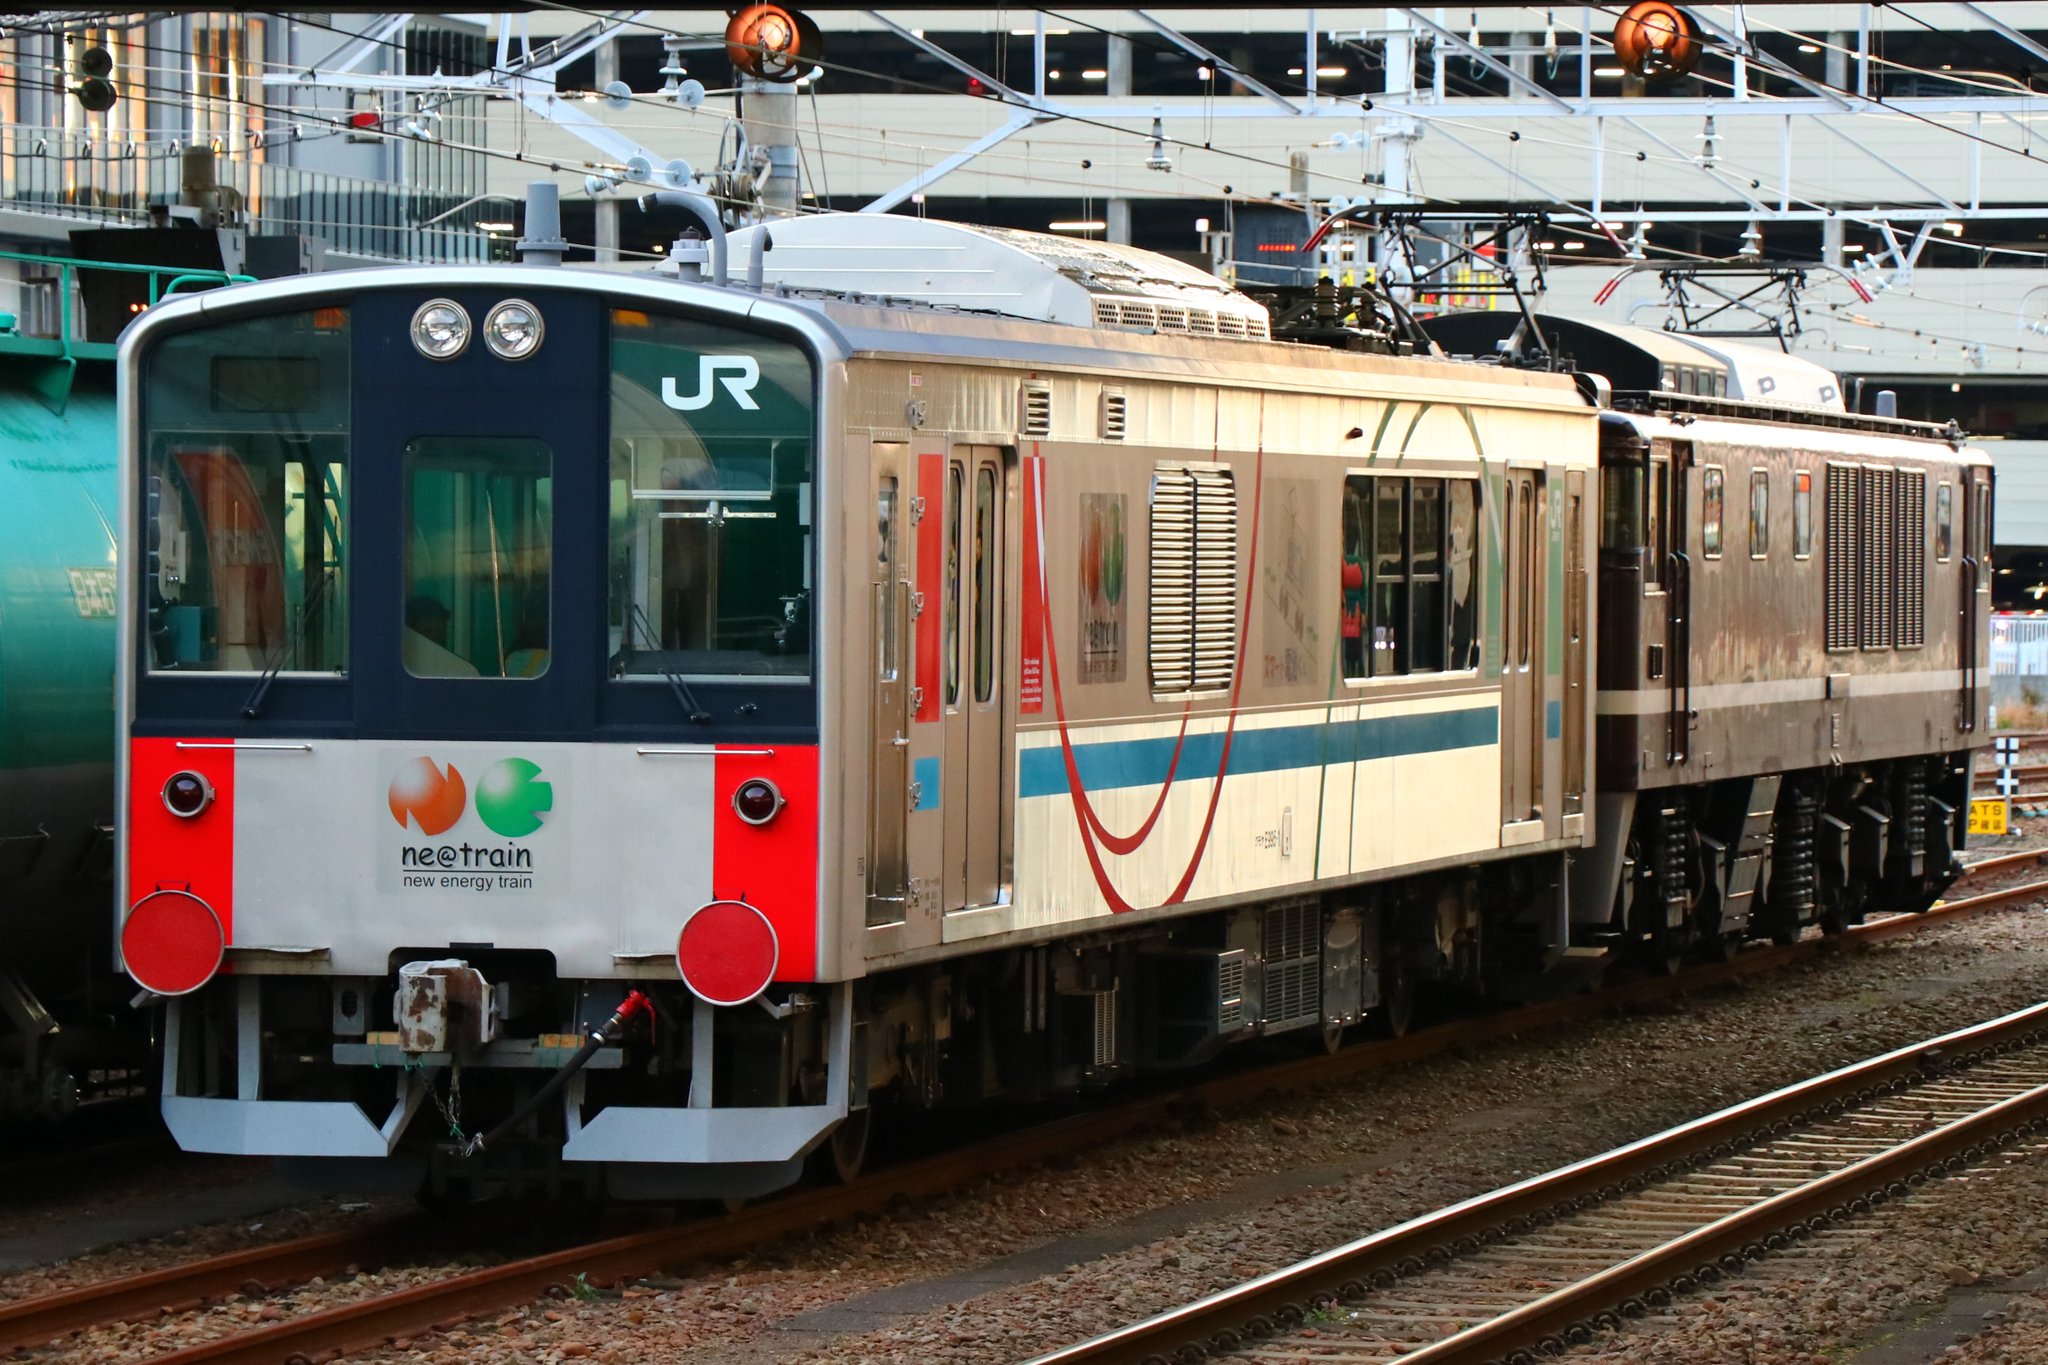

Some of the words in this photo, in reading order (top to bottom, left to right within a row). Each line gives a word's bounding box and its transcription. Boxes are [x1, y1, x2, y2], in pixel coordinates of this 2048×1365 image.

[661, 355, 760, 411] JR
[70, 570, 116, 617] 日本石
[1969, 805, 2002, 816] ATS
[401, 841, 532, 868] ne@train
[403, 876, 436, 888] new
[440, 876, 494, 892] energy
[499, 875, 533, 889] train
